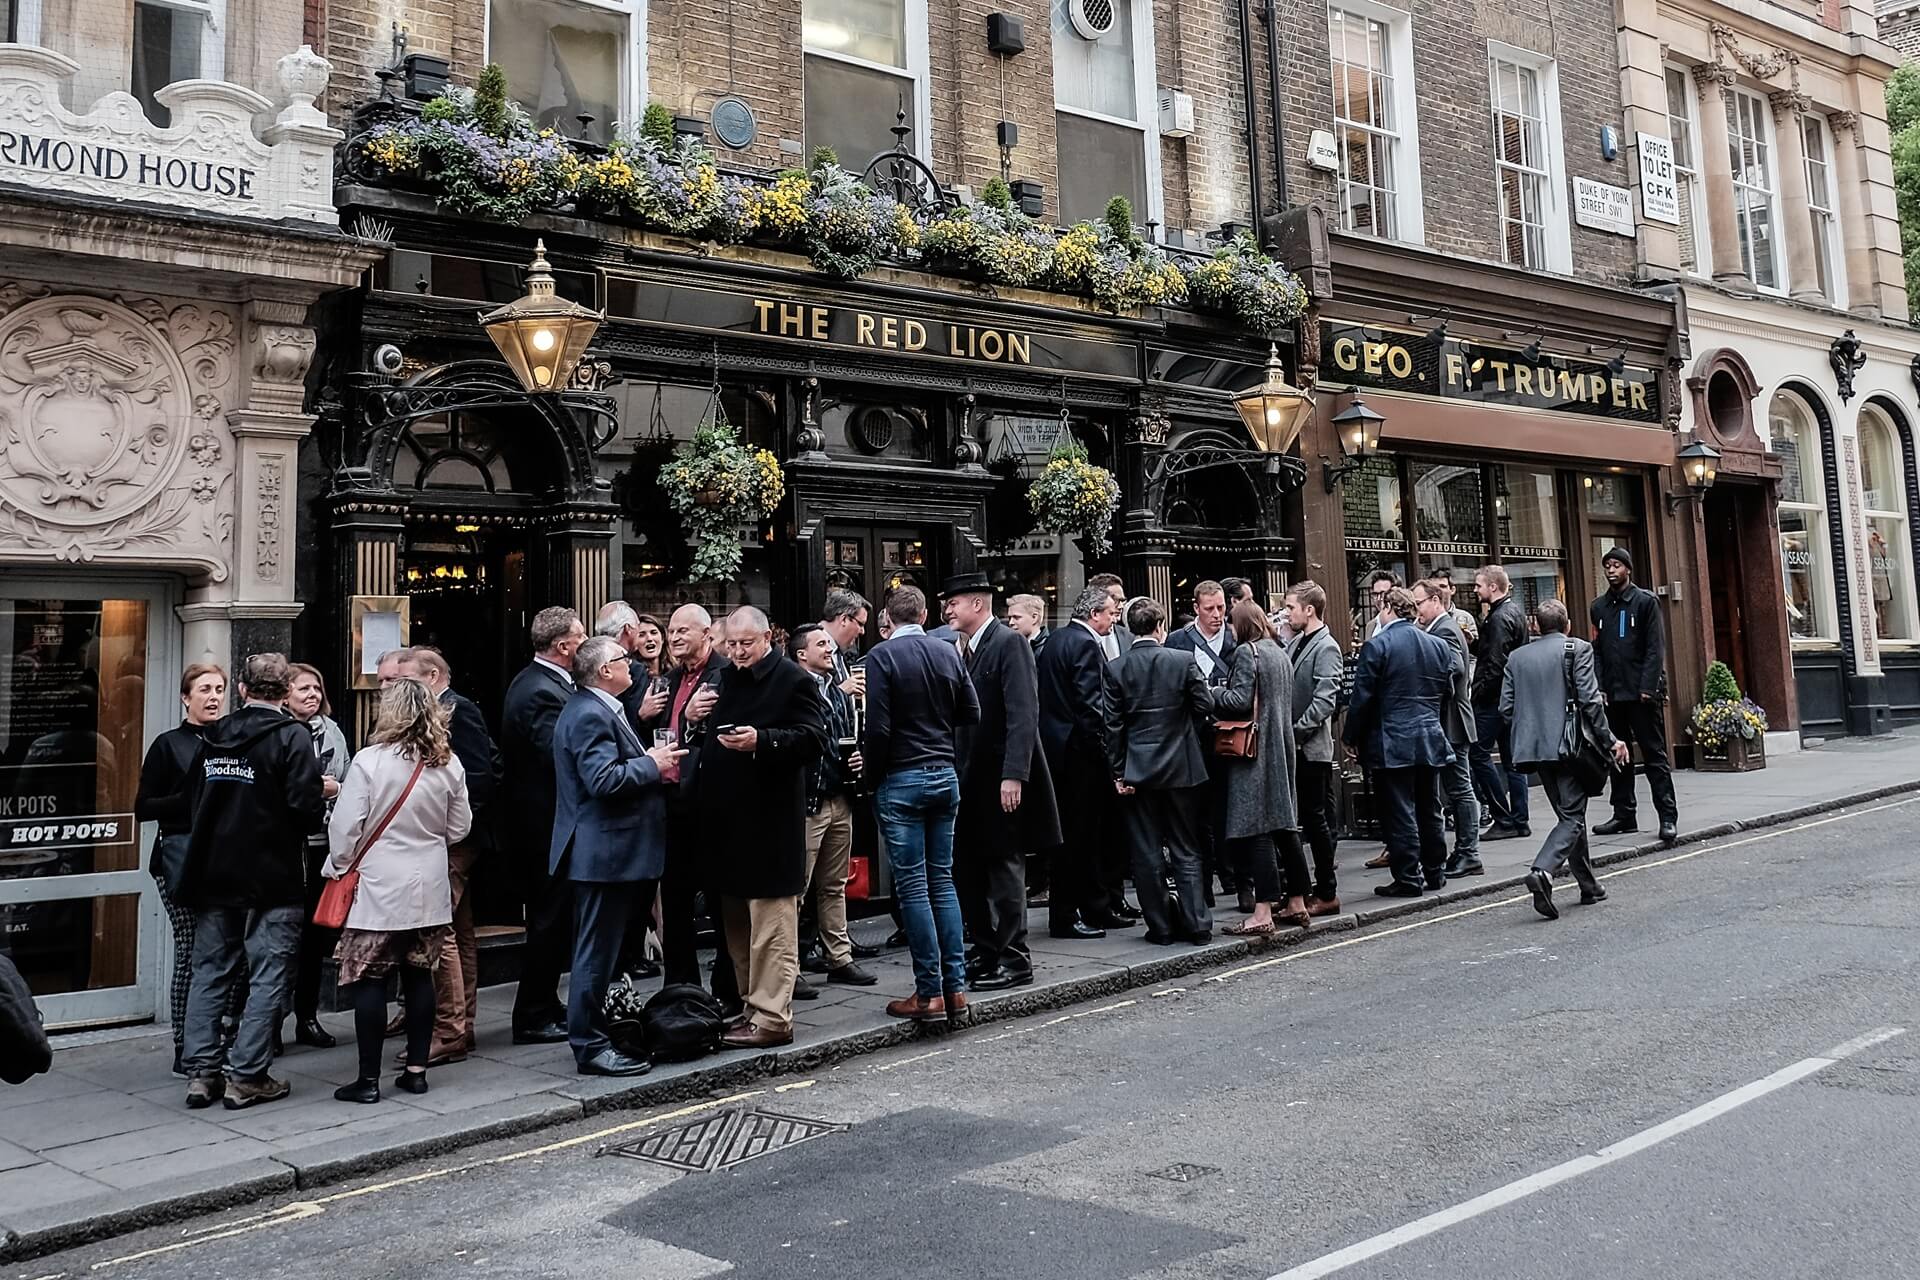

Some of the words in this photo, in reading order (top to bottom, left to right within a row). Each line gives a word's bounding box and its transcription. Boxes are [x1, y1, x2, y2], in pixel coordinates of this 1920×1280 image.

[1644, 140, 1668, 159] OFFICE
[139, 153, 256, 200] HOUSE
[1643, 155, 1654, 174] TO
[1656, 160, 1672, 180] LET
[1579, 182, 1598, 198] DUKE
[1600, 187, 1609, 200] OF
[1611, 191, 1629, 206] YORK
[1647, 182, 1673, 200] CFK
[1581, 197, 1605, 214] STREET
[1609, 204, 1623, 218] SW1
[753, 299, 829, 340] THE
[857, 313, 927, 351] RED
[950, 326, 1031, 364] LION
[1333, 337, 1426, 381] GEO.
[1490, 360, 1649, 411] TRUMPER
[1420, 543, 1485, 554] HAIRDRESSER
[1503, 546, 1511, 555] &
[1514, 547, 1560, 557] PERFUMER
[1788, 551, 1816, 565] SEASON
[203, 756, 239, 767] Australian
[205, 764, 255, 779] Bloodstock
[0, 797, 13, 816] K
[18, 795, 57, 815] POTS
[11, 825, 59, 843] HOT
[61, 822, 118, 840] POTS
[5, 923, 30, 933] EAT.
